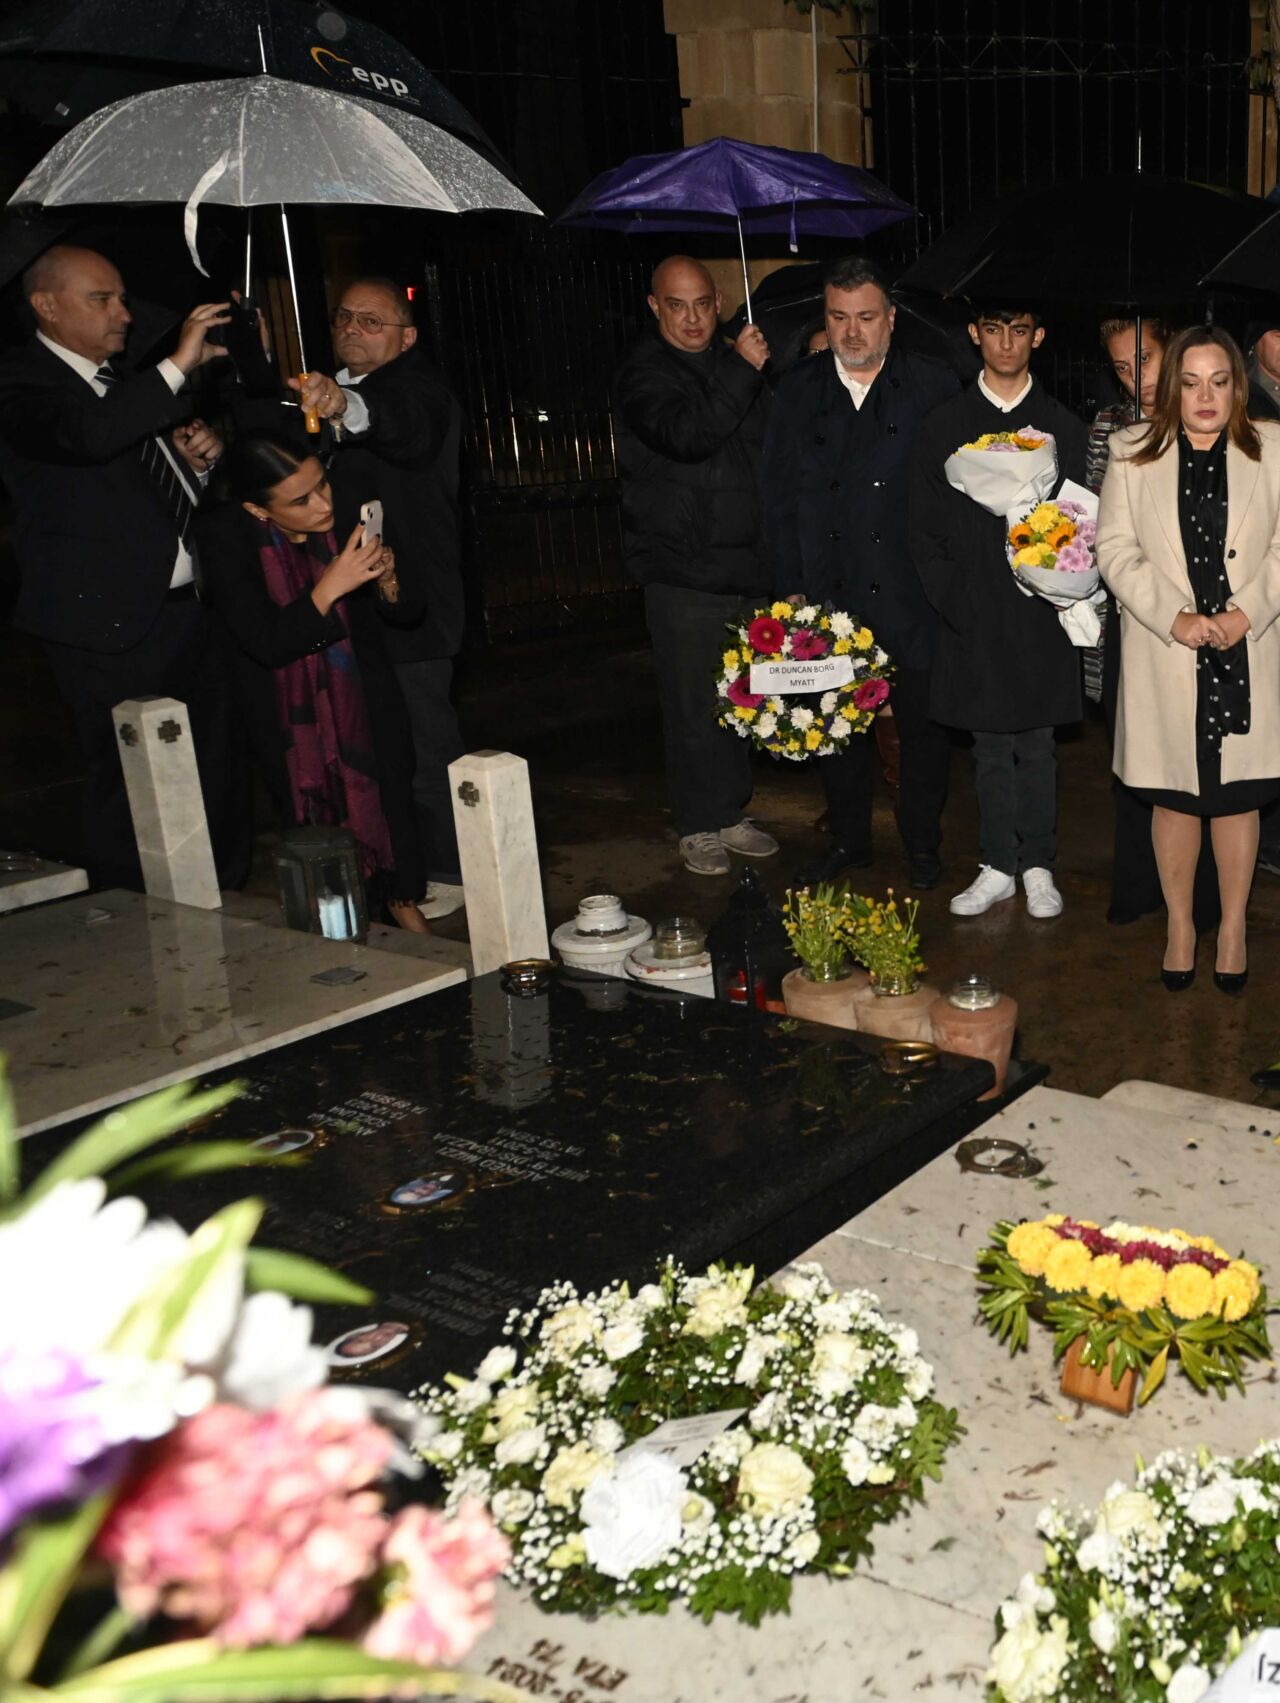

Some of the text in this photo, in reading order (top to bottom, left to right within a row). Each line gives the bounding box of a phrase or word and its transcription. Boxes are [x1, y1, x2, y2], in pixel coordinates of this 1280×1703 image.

[352, 66, 409, 96] epp
[769, 663, 835, 675] DR DUNCAN BORG
[789, 678, 816, 687] MYATT
